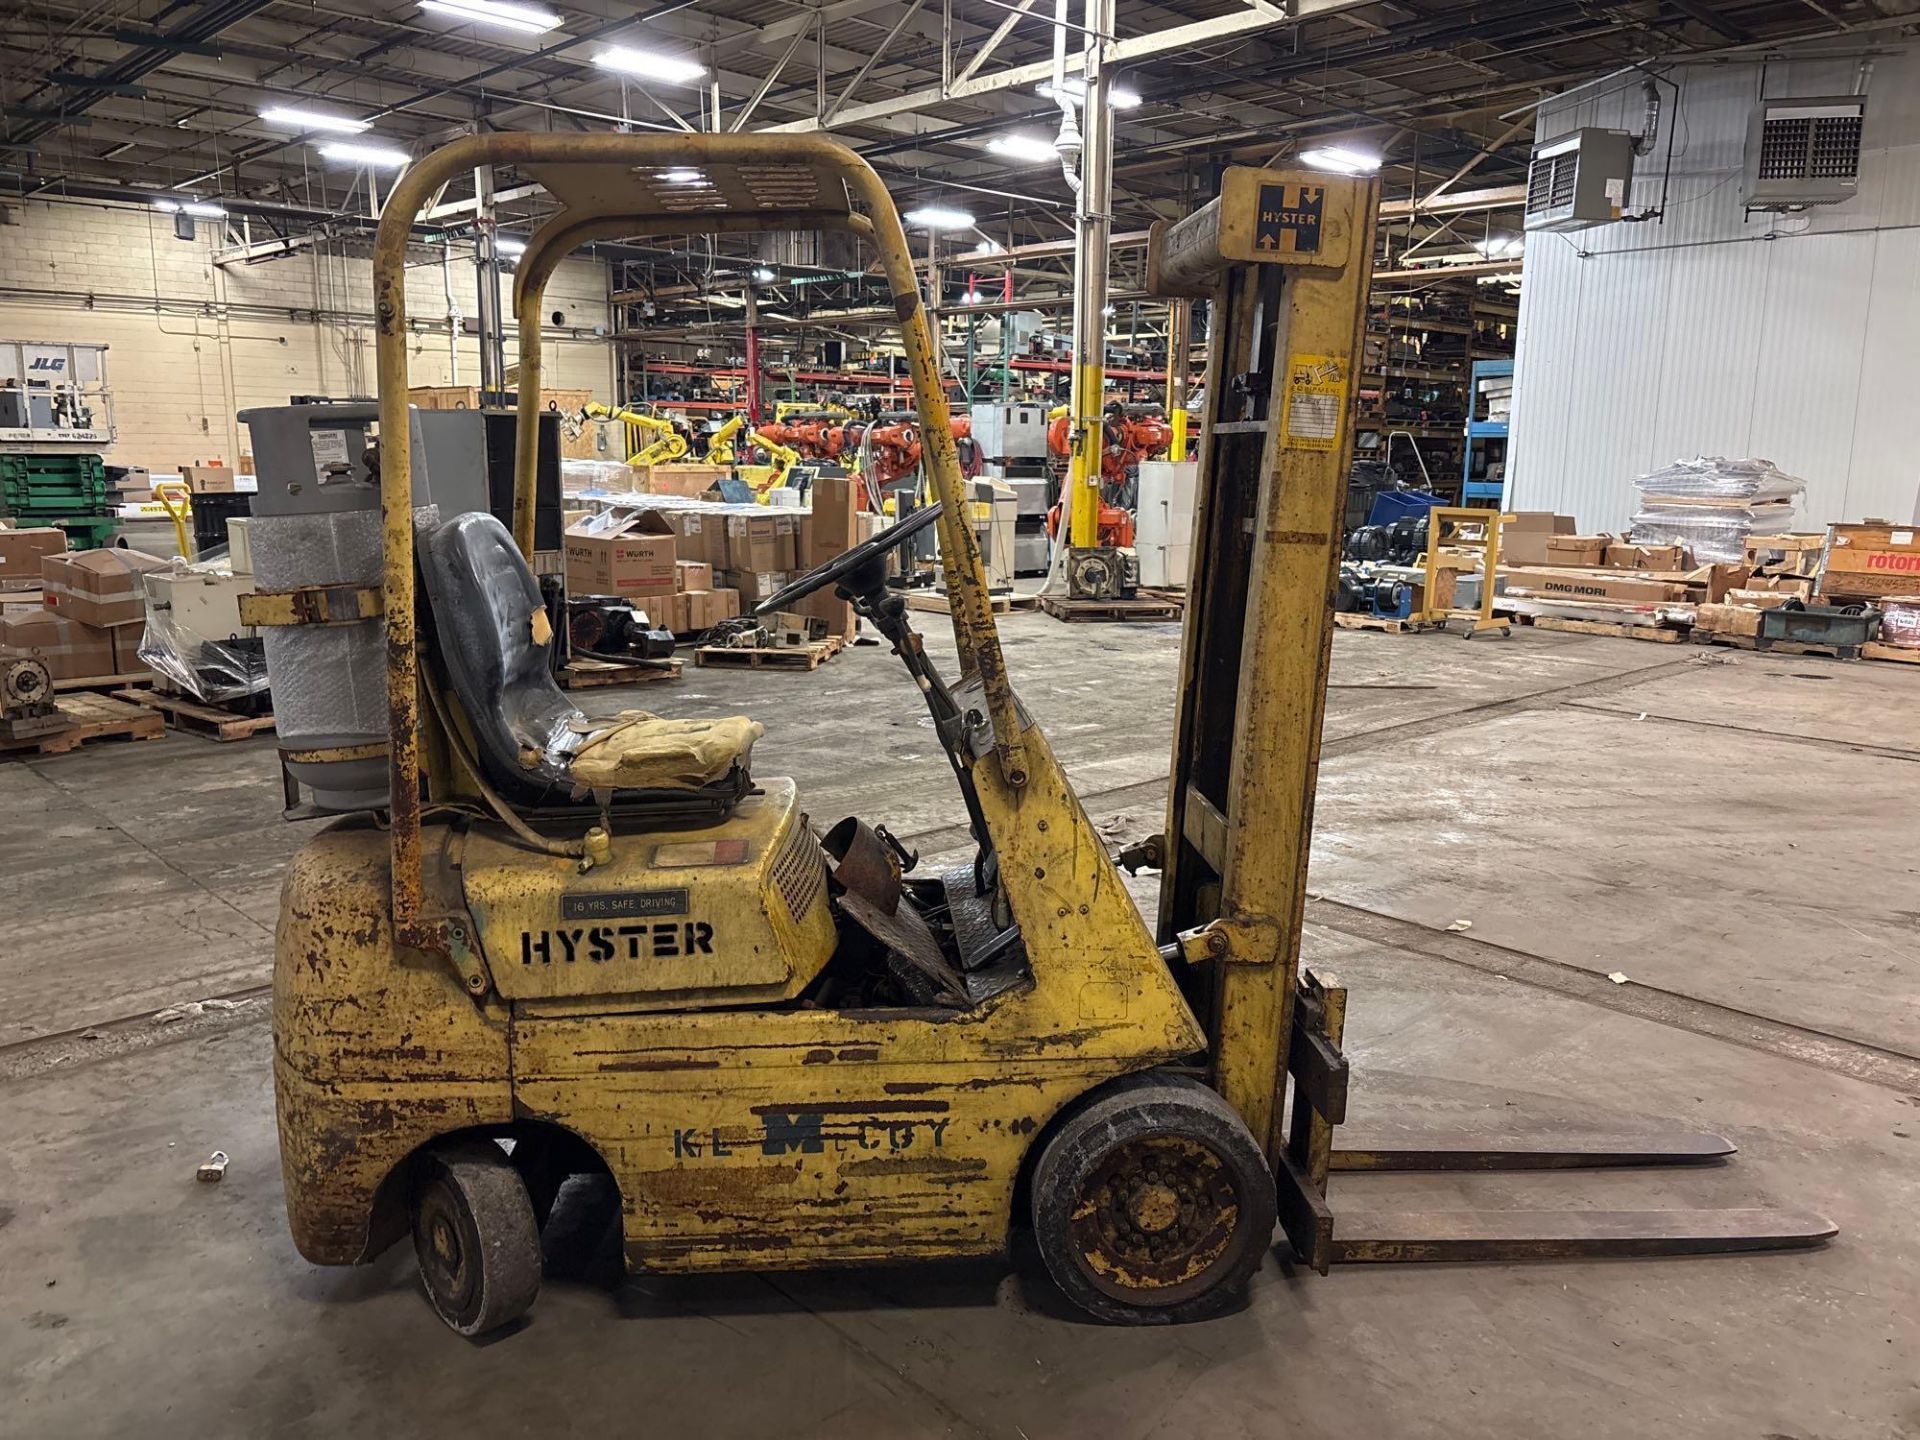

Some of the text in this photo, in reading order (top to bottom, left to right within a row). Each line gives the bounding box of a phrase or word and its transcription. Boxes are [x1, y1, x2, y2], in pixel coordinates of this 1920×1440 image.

[1263, 211, 1316, 225] HYSTER
[28, 357, 66, 370] JLG
[1544, 582, 1607, 597] DMG MORI
[573, 896, 676, 912] 16 YRS. SAFE DRIVING
[521, 922, 714, 964] HYSTER
